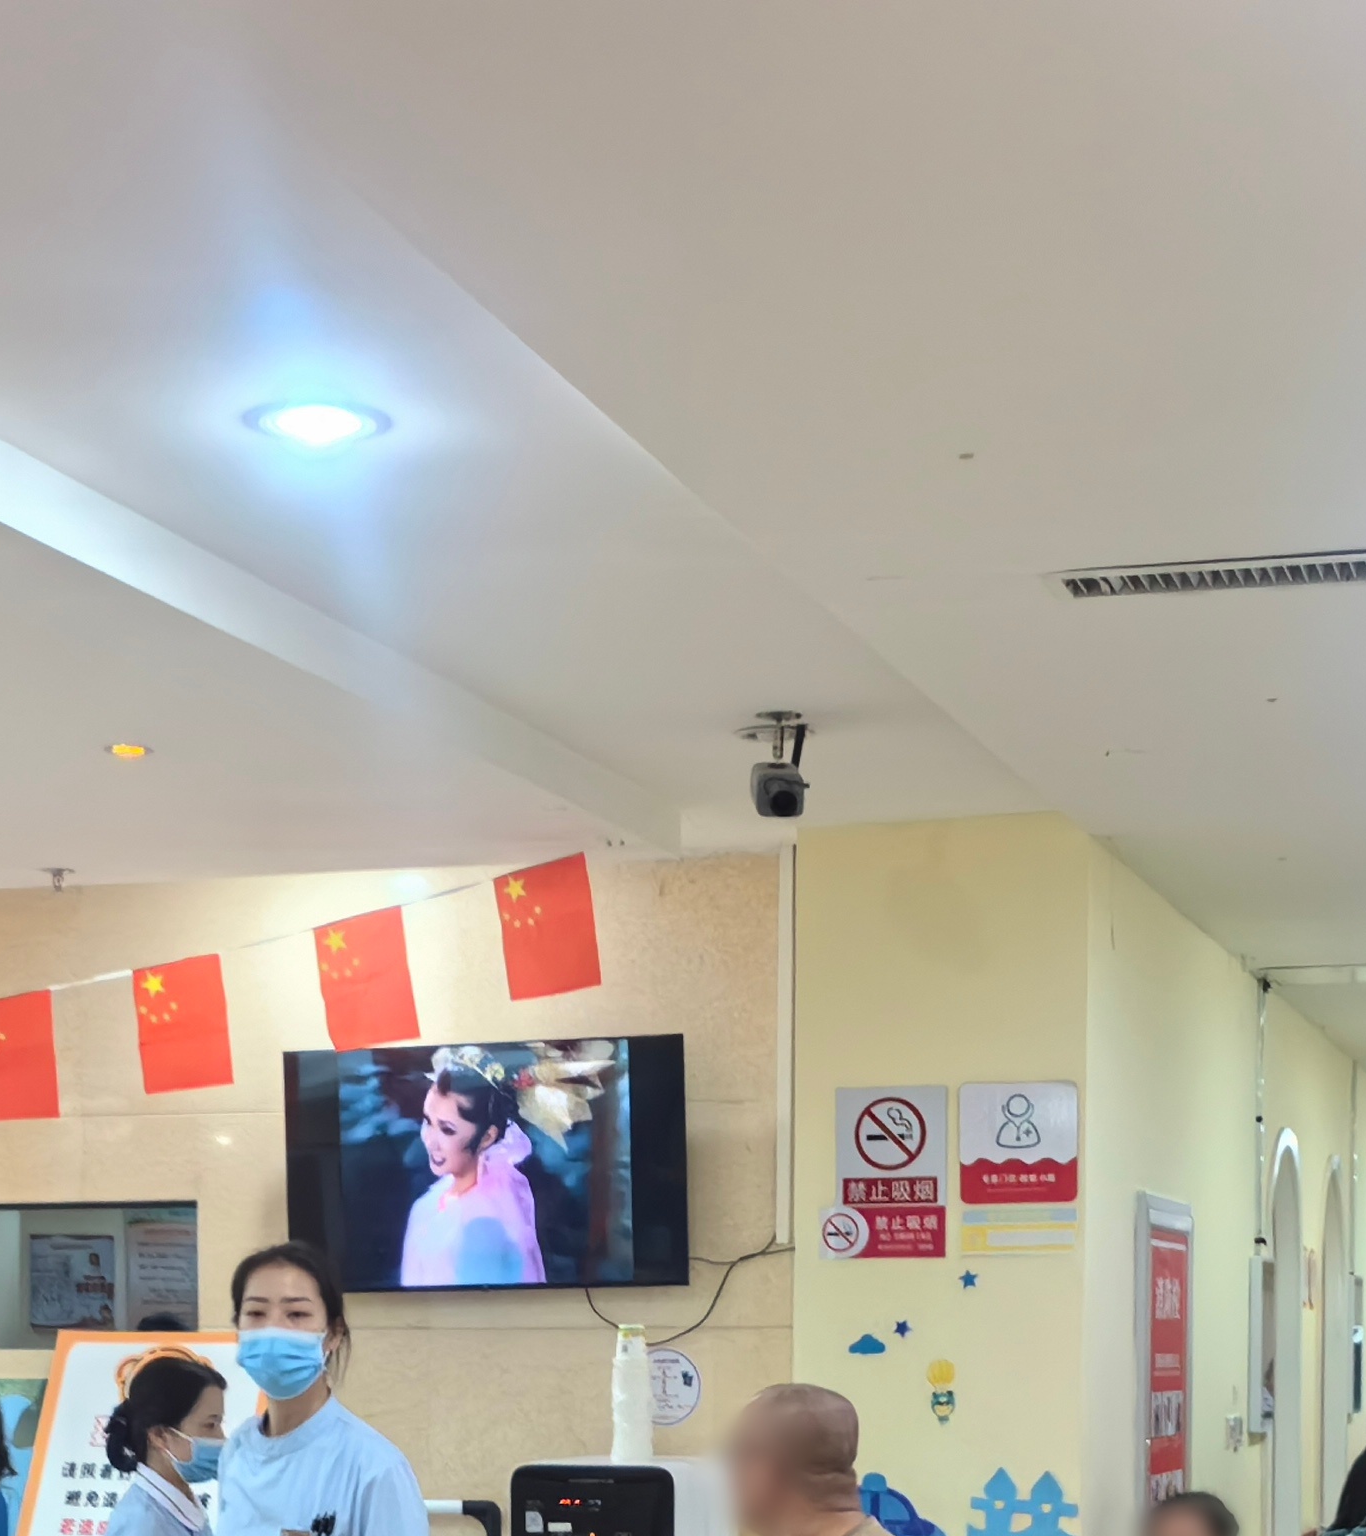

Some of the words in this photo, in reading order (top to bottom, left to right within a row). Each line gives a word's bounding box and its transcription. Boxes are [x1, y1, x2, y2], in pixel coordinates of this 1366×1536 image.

[847, 1180, 936, 1203] 禁止吸烟
[875, 1214, 939, 1231] 禁止吸烟
